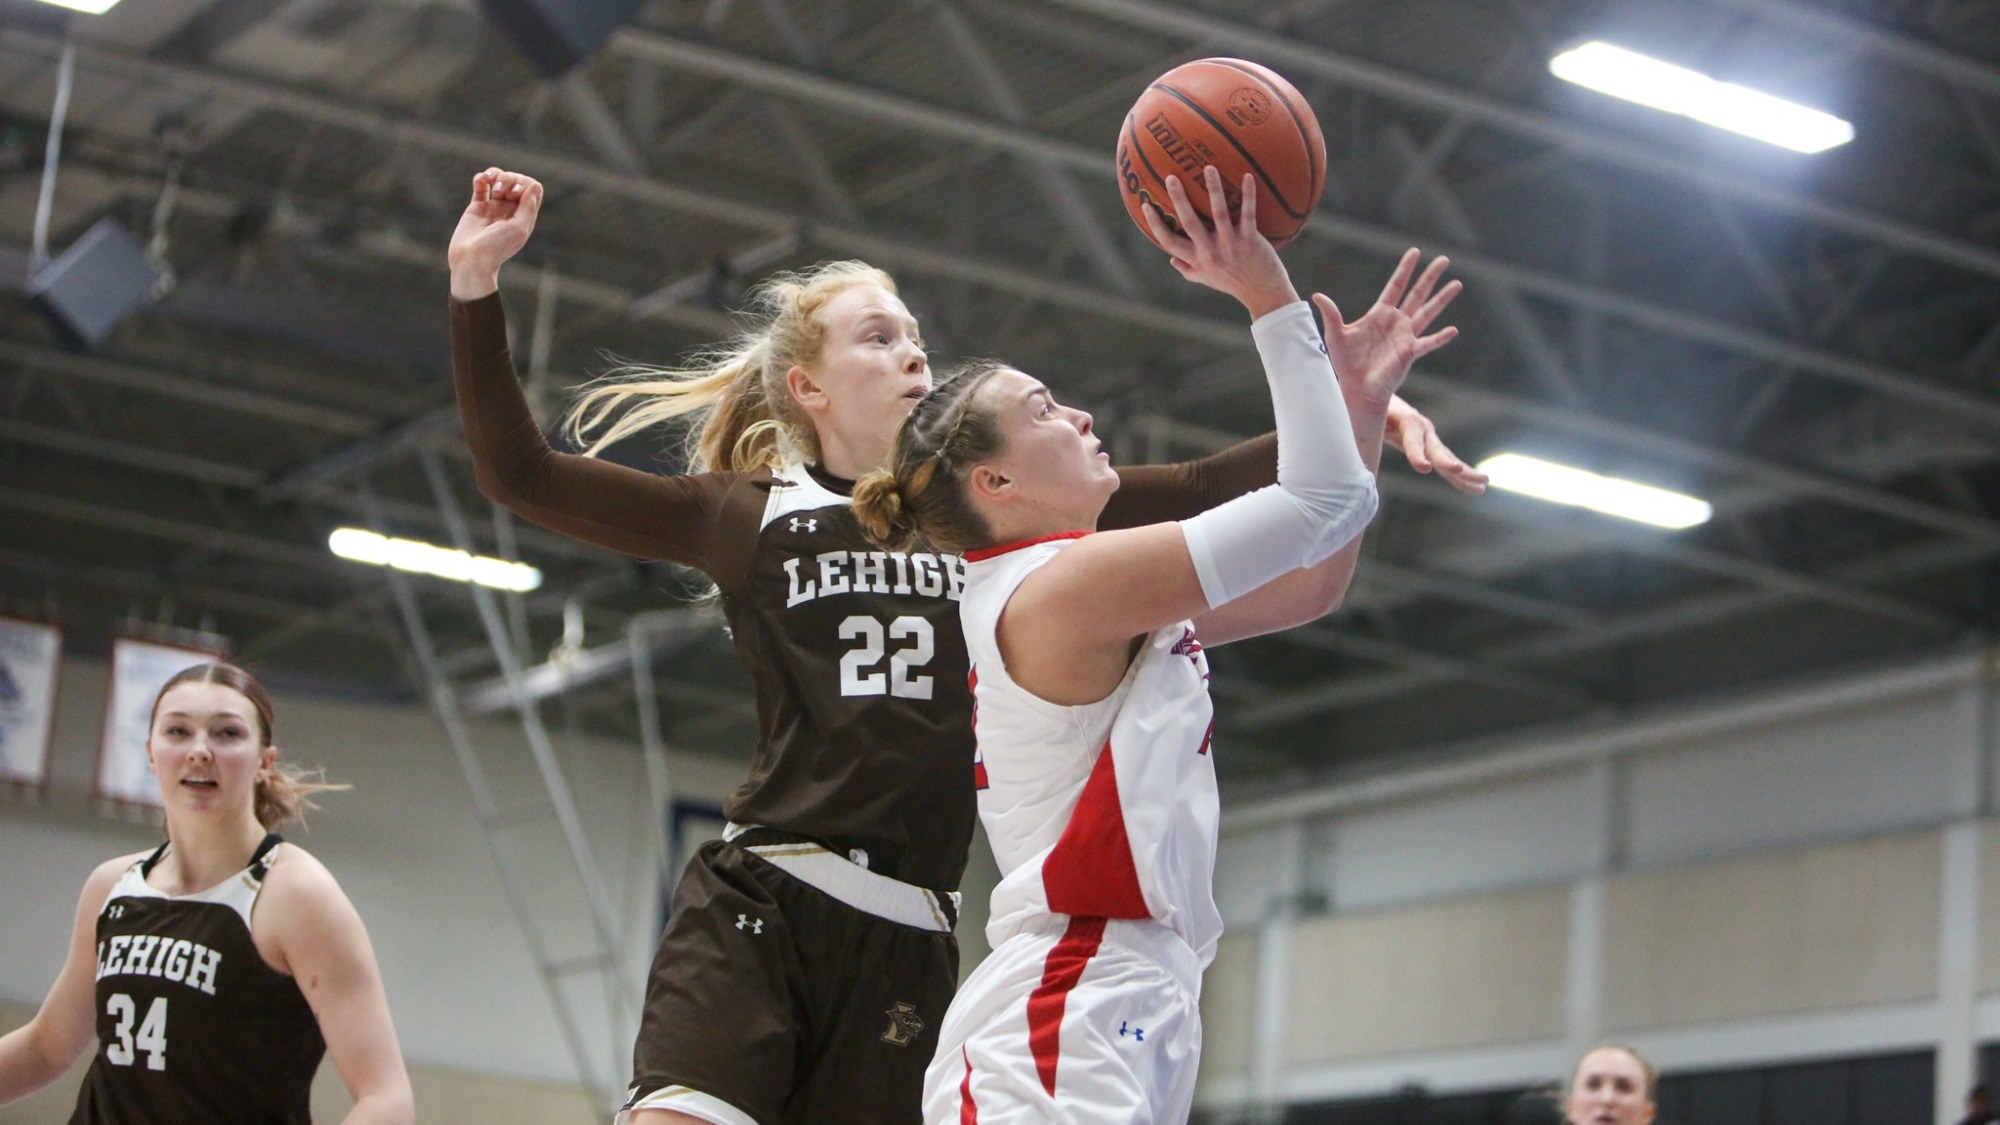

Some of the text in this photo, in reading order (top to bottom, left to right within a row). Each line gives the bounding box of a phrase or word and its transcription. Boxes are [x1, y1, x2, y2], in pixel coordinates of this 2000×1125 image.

[783, 551, 968, 608] LEHIGH
[838, 615, 935, 700] 22
[96, 935, 222, 995] LEHIGH
[106, 993, 168, 1071] 34
